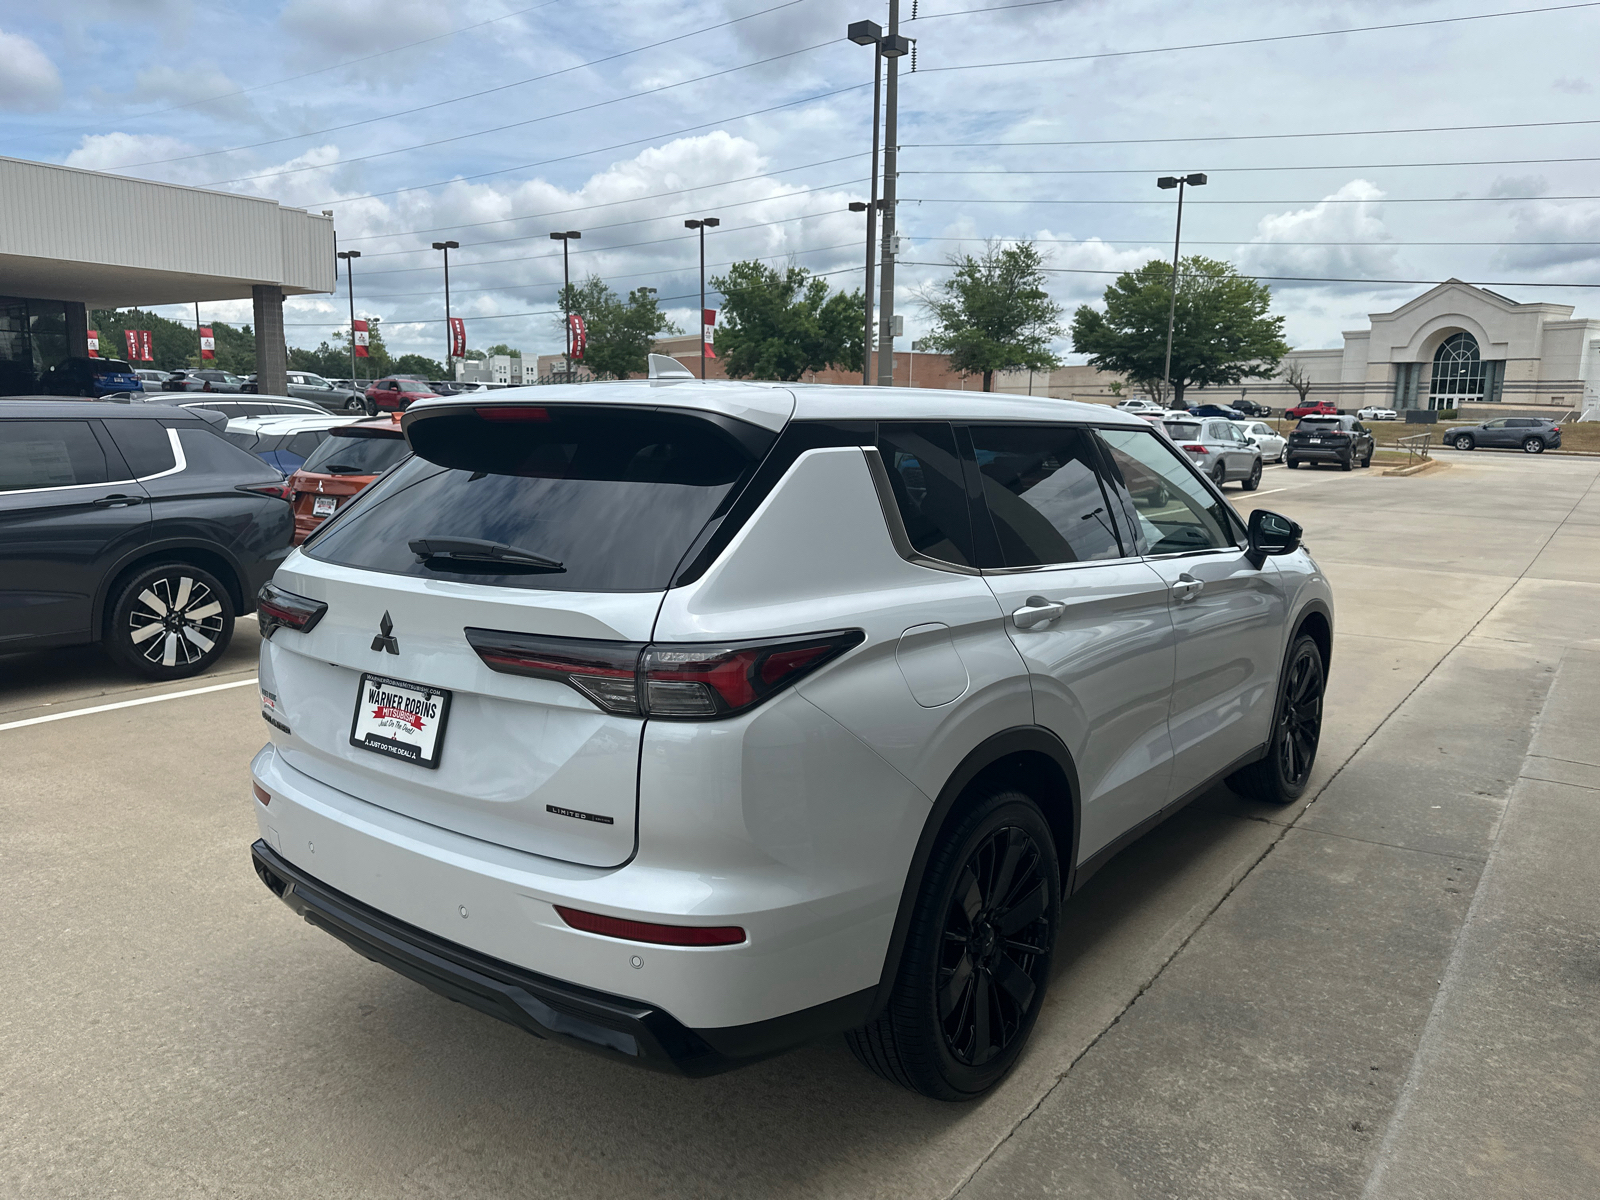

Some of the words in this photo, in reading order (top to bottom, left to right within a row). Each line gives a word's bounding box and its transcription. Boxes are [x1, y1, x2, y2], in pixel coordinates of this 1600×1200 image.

[368, 688, 403, 709] WARNER
[404, 697, 437, 719] ROBINS
[382, 707, 416, 724] MITSUBISHI
[369, 740, 381, 749] JUST
[380, 743, 388, 751] DO
[388, 745, 398, 753] THE
[552, 807, 587, 819] LIMITED
